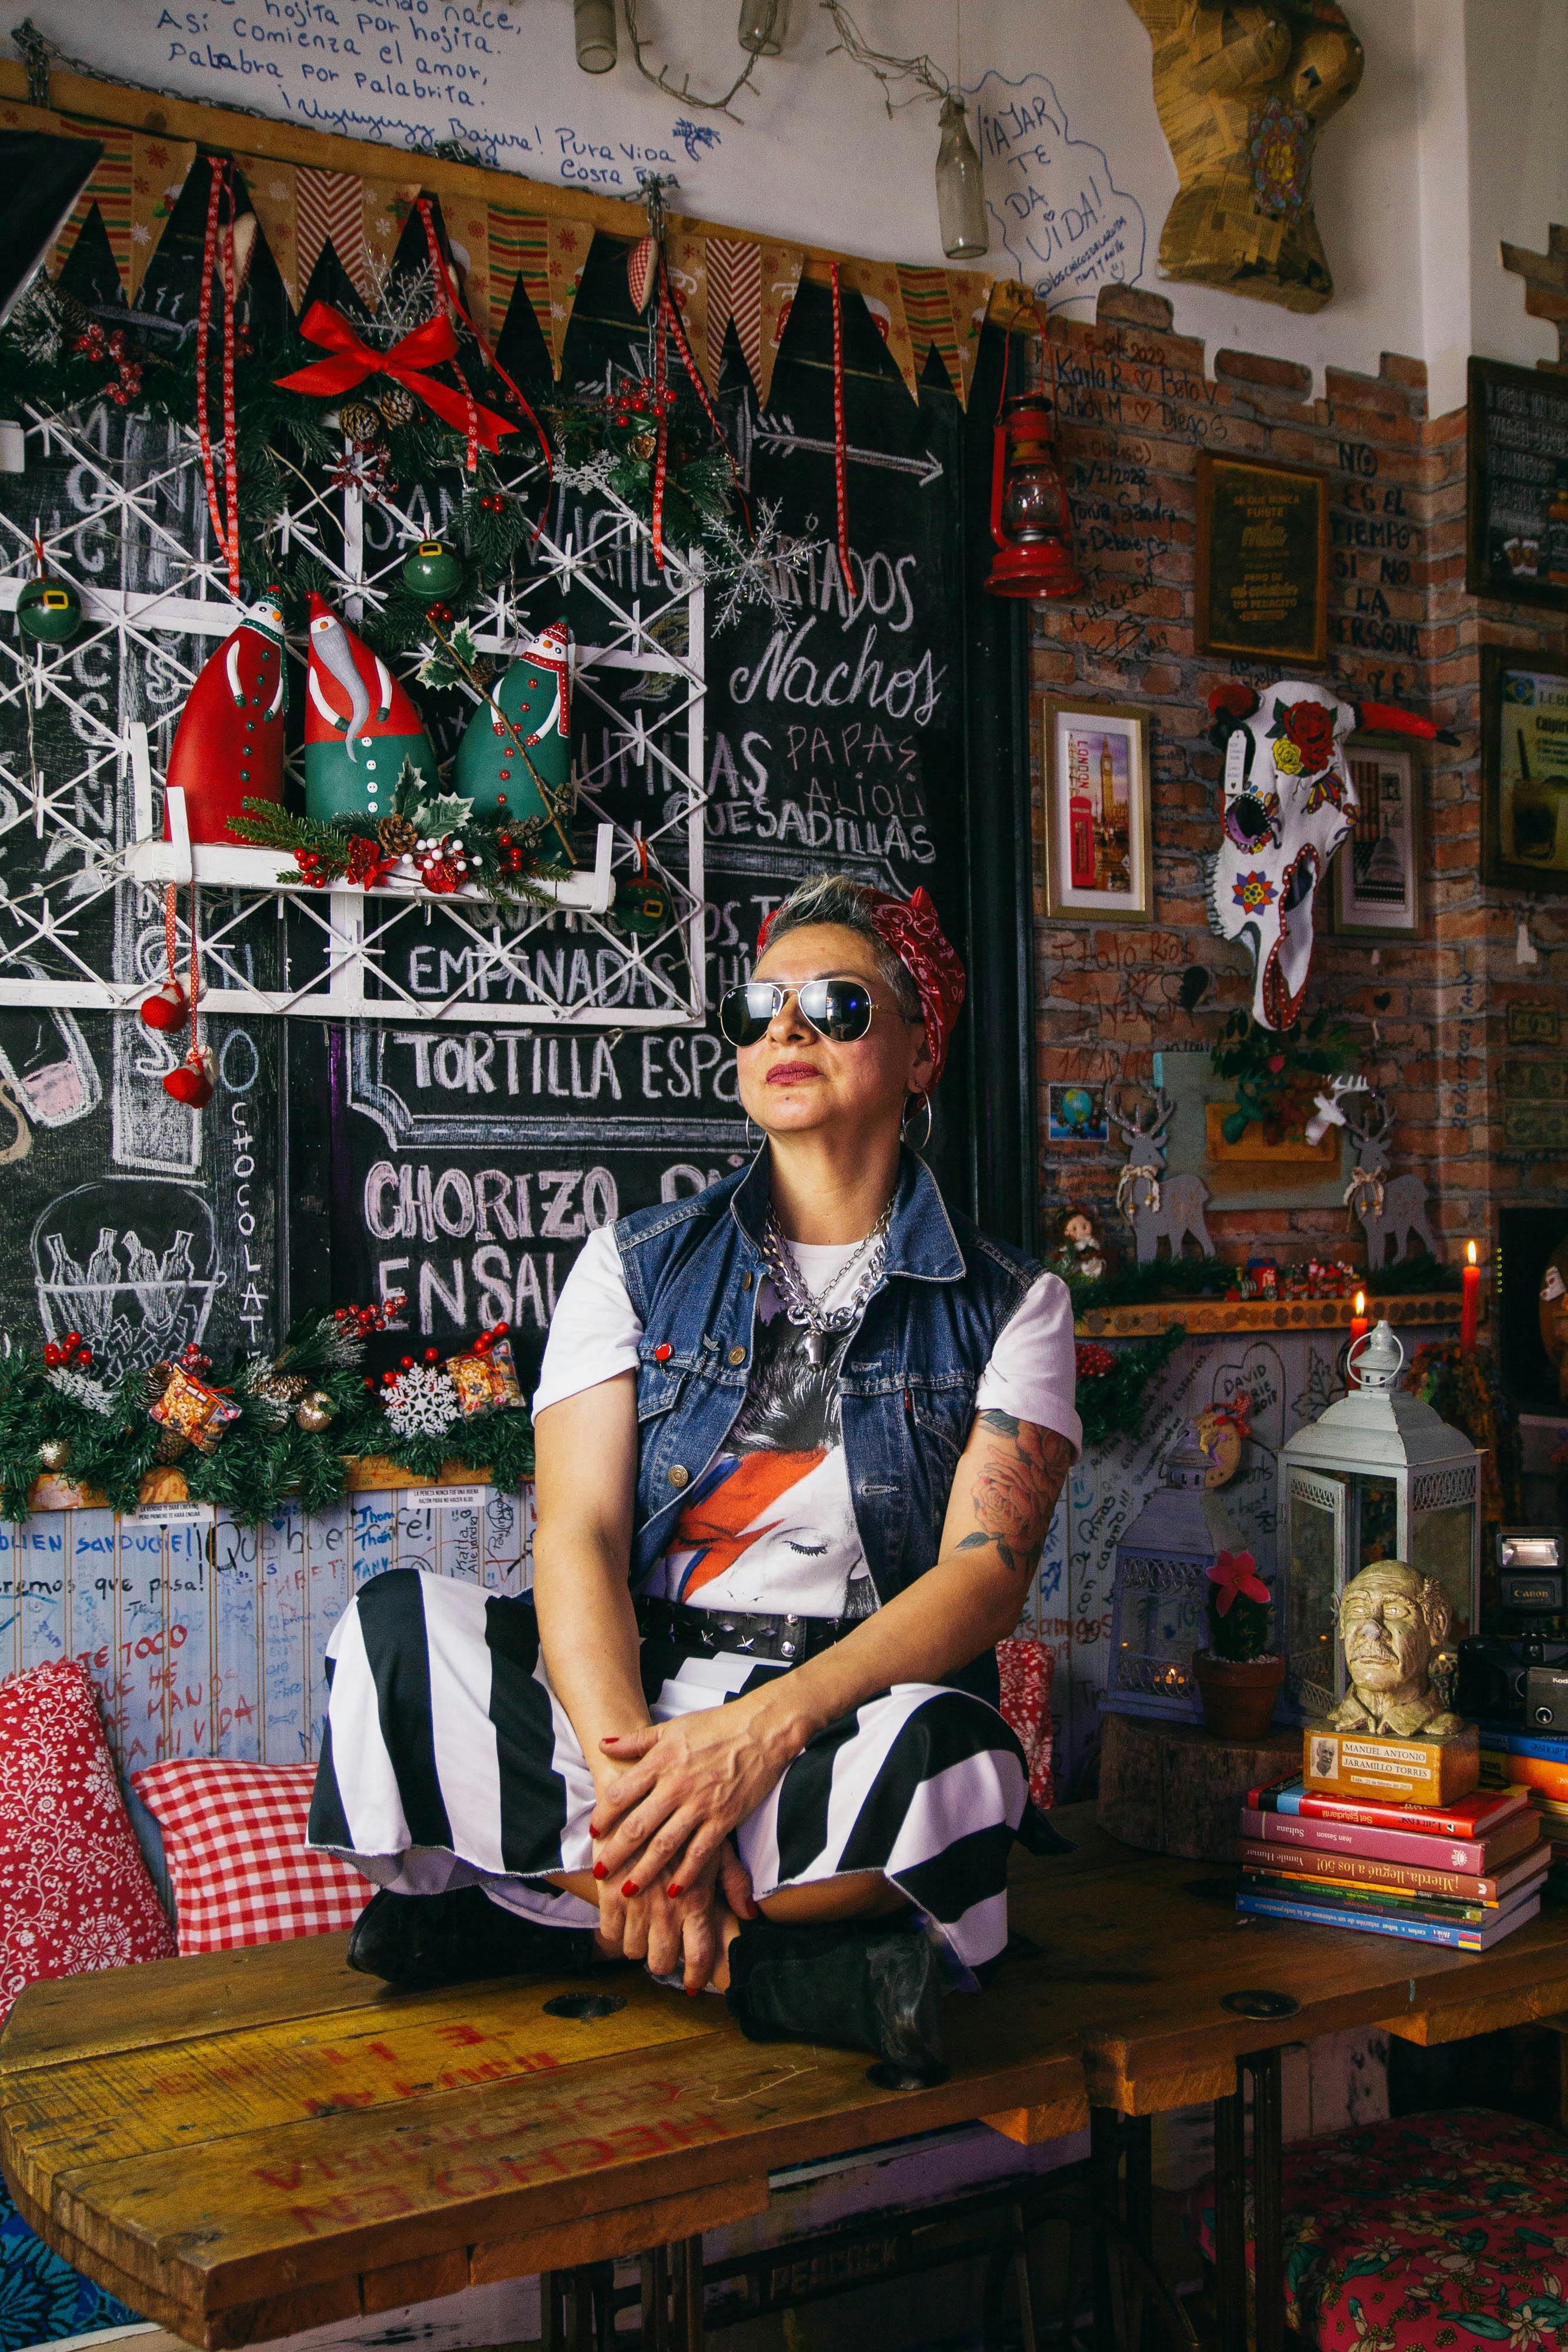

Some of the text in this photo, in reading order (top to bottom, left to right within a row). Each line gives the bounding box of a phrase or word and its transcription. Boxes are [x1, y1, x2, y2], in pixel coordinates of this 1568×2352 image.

[380, 39, 403, 64] el
[1008, 144, 1051, 175] TE
[1004, 185, 1049, 219] DA
[1338, 441, 1379, 477] NO
[1356, 587, 1390, 618] LA
[728, 614, 948, 726] Nachos
[787, 722, 917, 771] PAPAS
[1077, 740, 1089, 789] LONDON
[408, 944, 677, 1010] EMPANADAS
[393, 1028, 623, 1100] TORTILLA
[364, 1160, 619, 1242] CHORIZO
[232, 1101, 269, 1360] CHOCOLAT
[95, 1578, 133, 1600] que
[1513, 1588, 1550, 1598] Canon
[1345, 1743, 1425, 1761] MANUEL ANTONIO
[1345, 1758, 1427, 1777] JARAMILLO TORRES
[1276, 1825, 1305, 1838] Sultana
[1316, 1832, 1337, 1842] Sasson
[1338, 1833, 1352, 1843] Jean
[1338, 1862, 1355, 1876] los
[1358, 1864, 1365, 1873] a
[283, 2110, 731, 2236] HECHO EN
